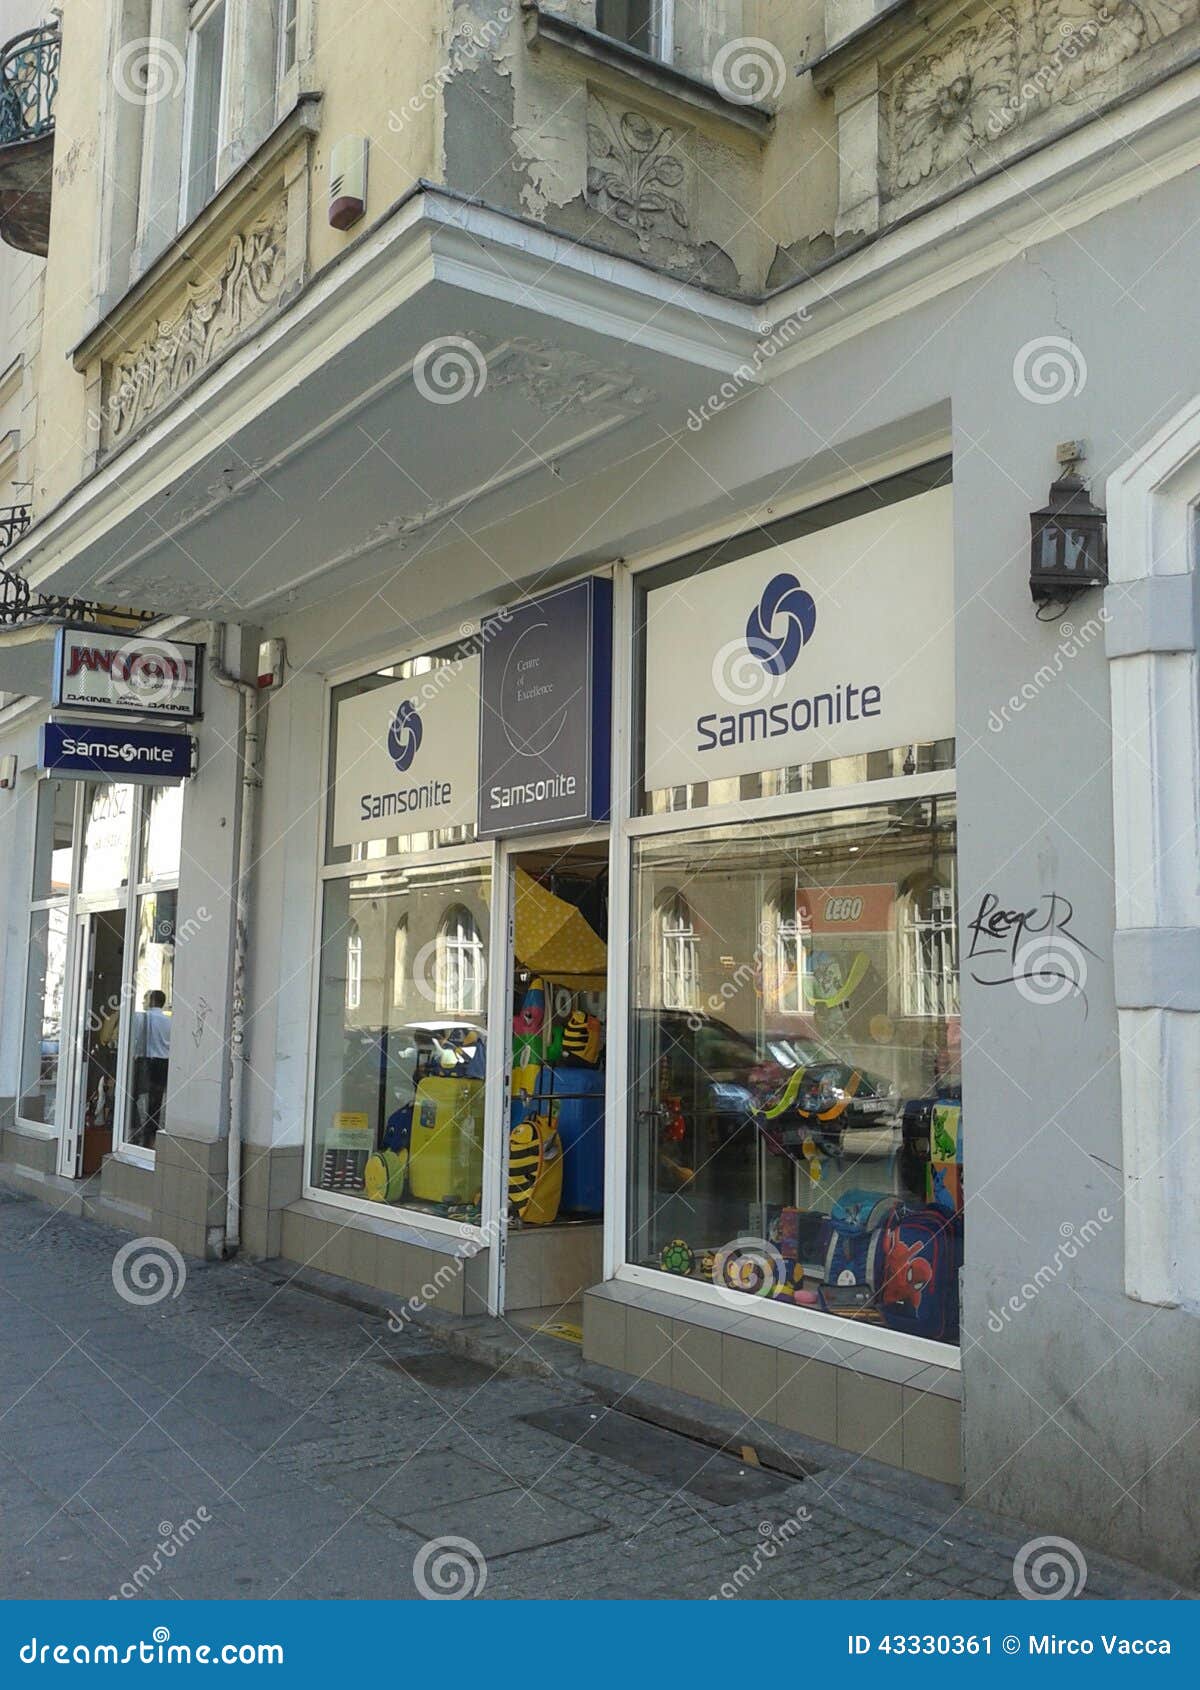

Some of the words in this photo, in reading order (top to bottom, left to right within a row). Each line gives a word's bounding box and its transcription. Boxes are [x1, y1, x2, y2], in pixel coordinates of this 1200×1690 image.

[66, 694, 112, 704] DAKINE
[147, 702, 191, 712] DAKINE
[697, 683, 882, 751] Samsonite
[61, 739, 174, 763] Samsonite
[360, 780, 452, 821] Samsonite
[490, 773, 576, 810] Samsonite
[824, 896, 864, 921] LEGO
